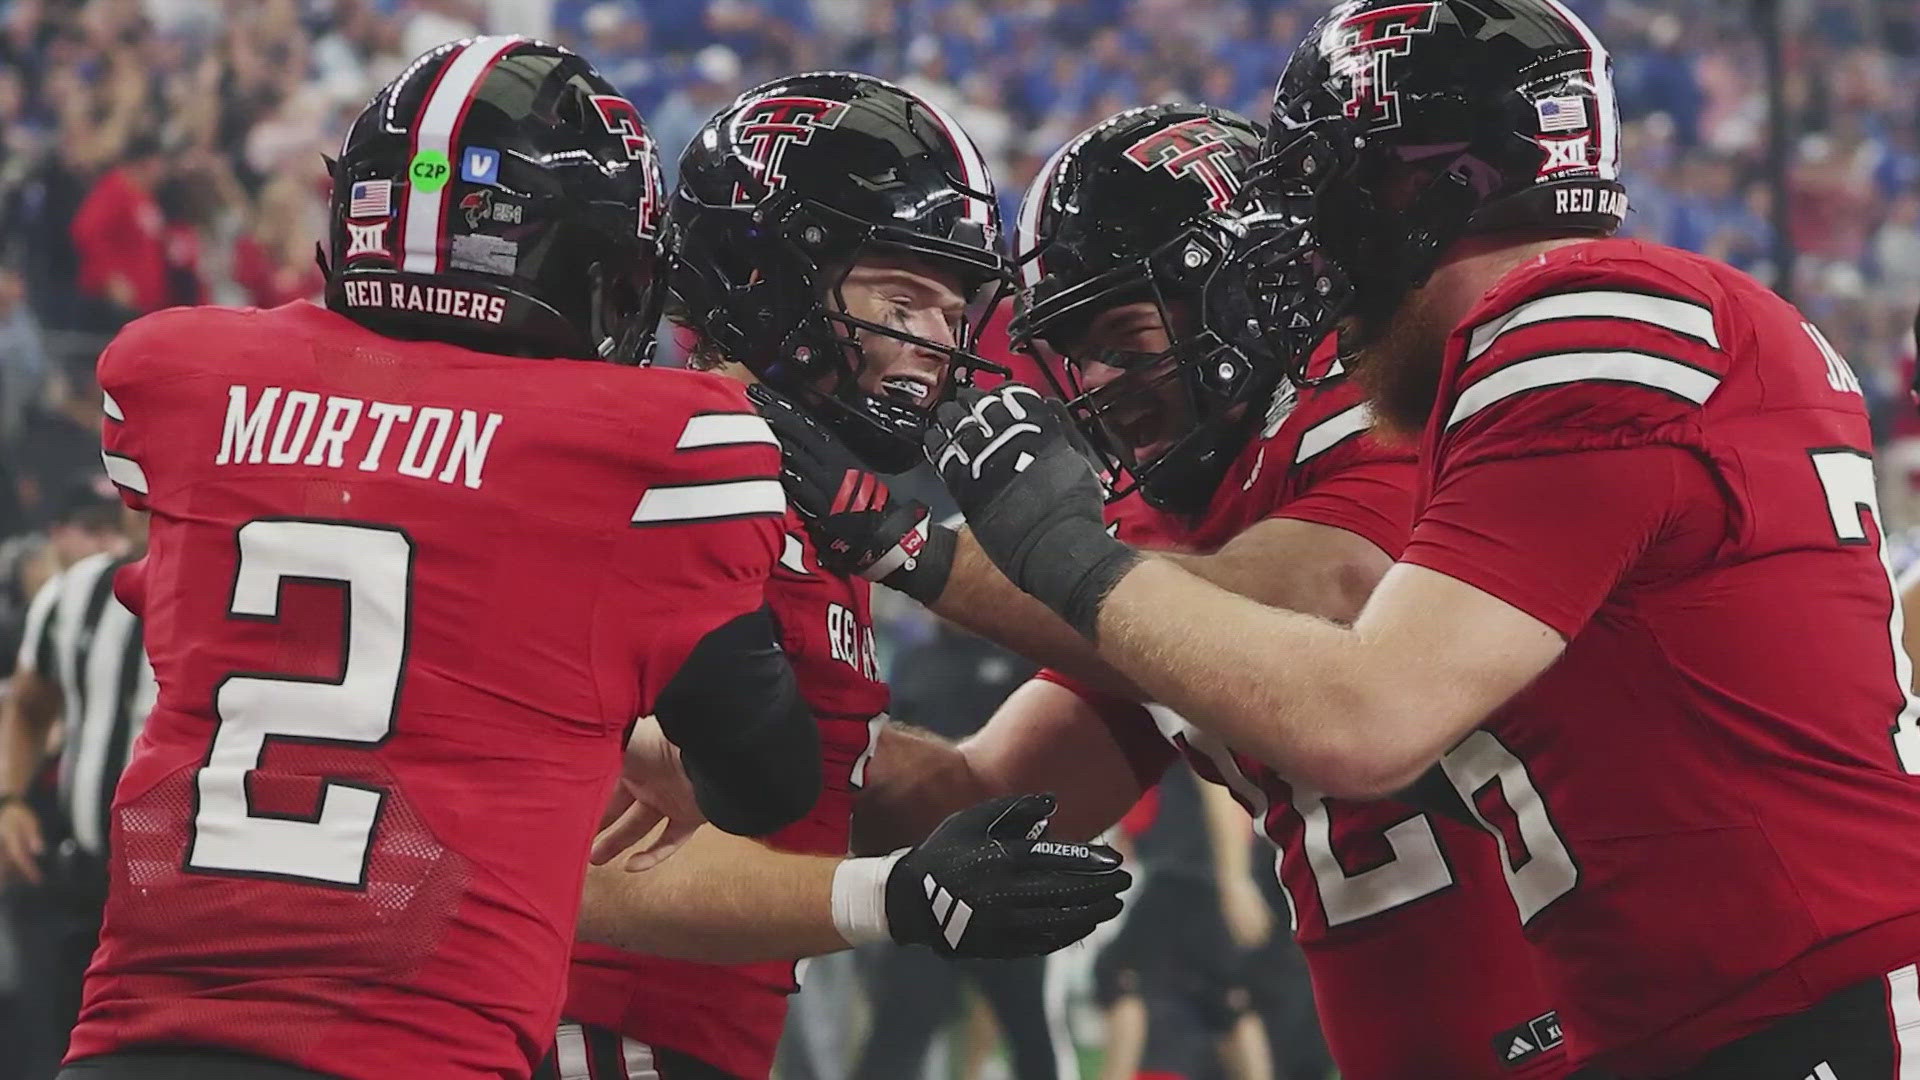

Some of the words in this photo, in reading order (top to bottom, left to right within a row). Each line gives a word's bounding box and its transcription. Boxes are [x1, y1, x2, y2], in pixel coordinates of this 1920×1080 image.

[413, 163, 447, 180] C2P
[1555, 188, 1594, 214] RED
[347, 221, 391, 258] XII
[343, 281, 383, 307] RED
[390, 283, 506, 324] RAIDERS
[214, 384, 503, 490] MORTON
[185, 517, 415, 888] 2
[1030, 842, 1090, 858] ADIZERO
[1546, 1024, 1564, 1041] XI
